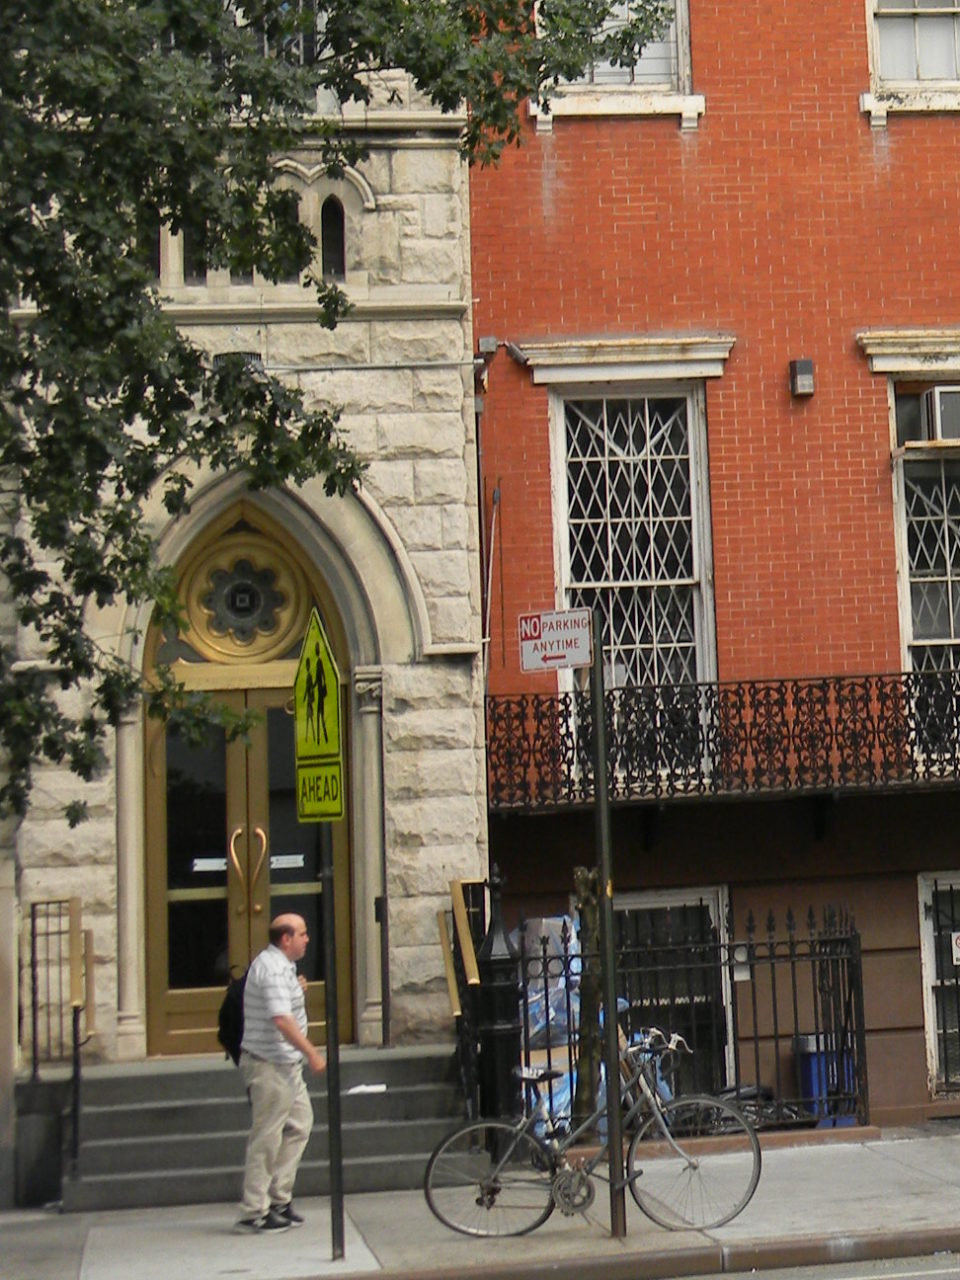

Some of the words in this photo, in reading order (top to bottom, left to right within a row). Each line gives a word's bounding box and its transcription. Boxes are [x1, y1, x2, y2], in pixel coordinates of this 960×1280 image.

[520, 617, 540, 638] NO
[541, 618, 588, 632] PARKING
[532, 637, 580, 652] ANYTIME
[300, 774, 339, 803] AHEAD
